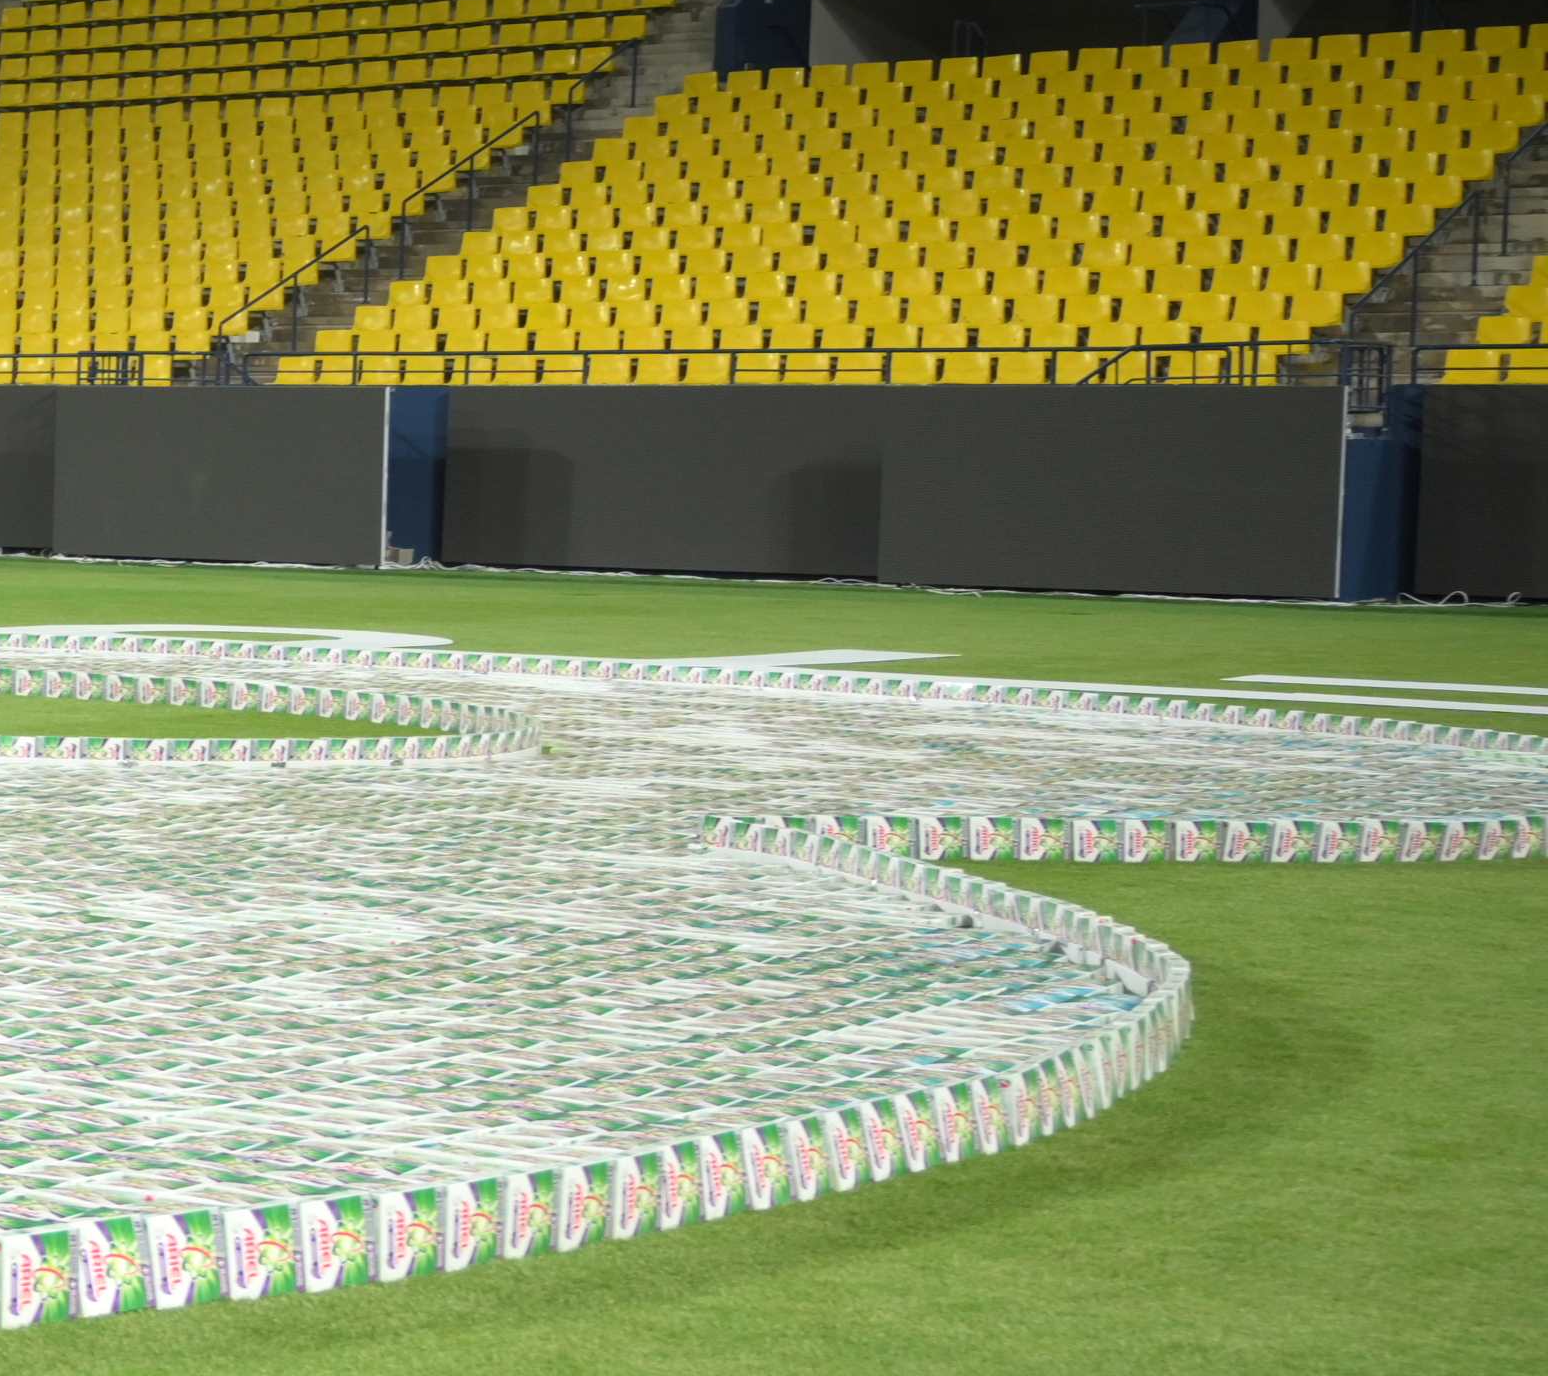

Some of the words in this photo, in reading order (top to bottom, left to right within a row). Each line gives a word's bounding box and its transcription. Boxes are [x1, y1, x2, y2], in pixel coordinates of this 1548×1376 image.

[317, 1218, 332, 1270] ARIEL
[395, 1210, 405, 1260] ARIEL
[461, 1200, 471, 1249] ARIEL
[88, 1240, 107, 1291] ARIEL
[165, 1233, 182, 1285] ARIEL
[243, 1228, 258, 1279] ARIEL
[19, 1253, 32, 1306] ARIEL
